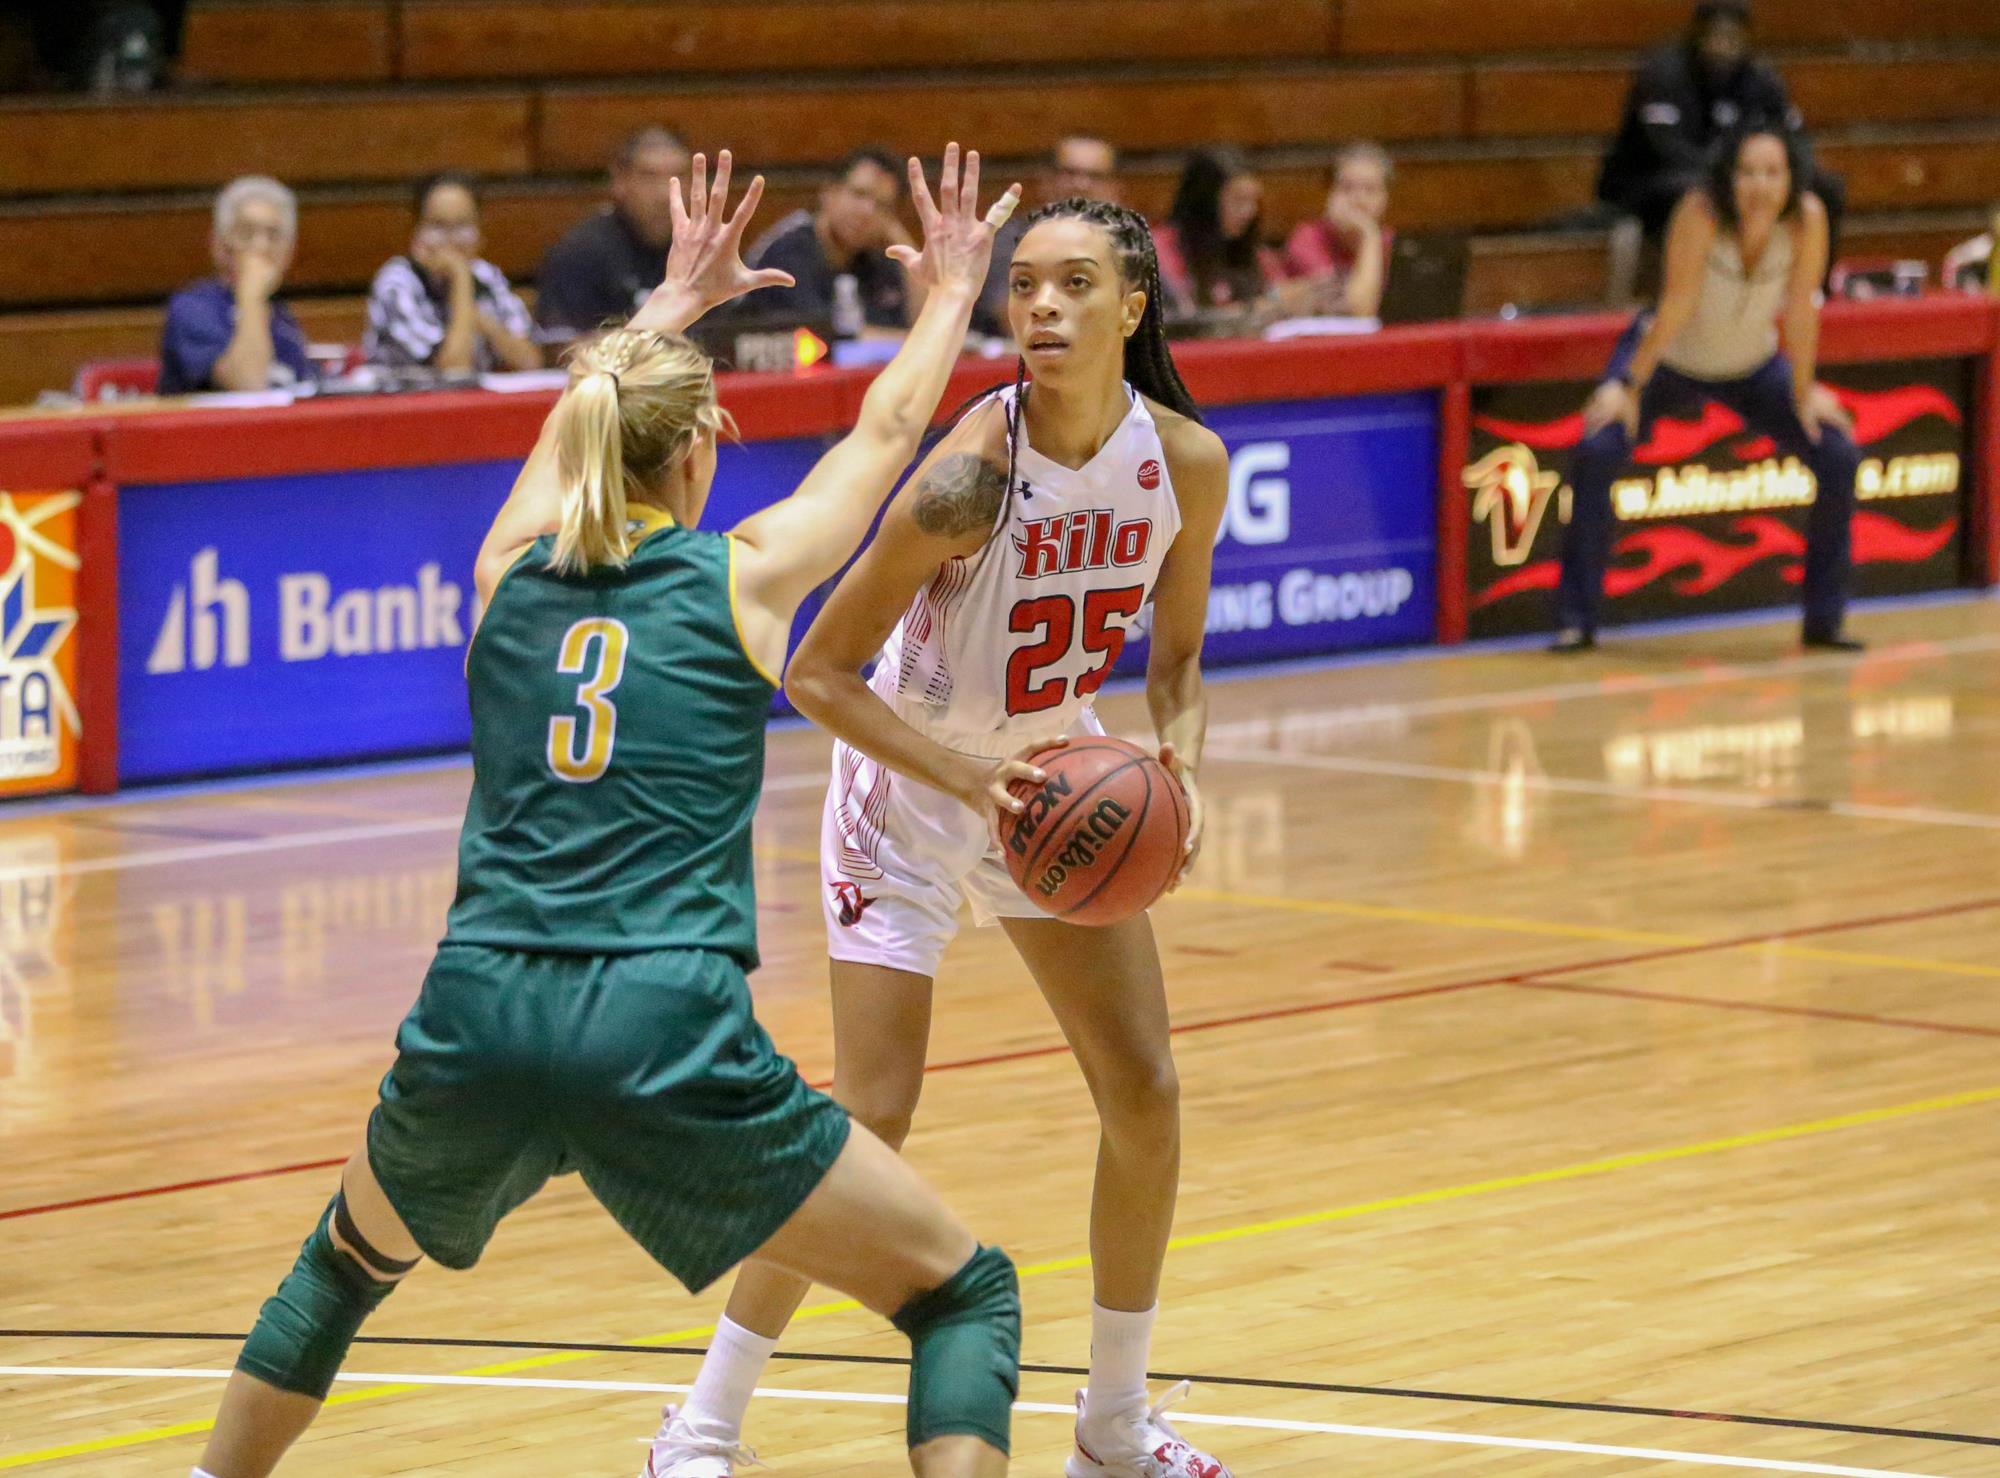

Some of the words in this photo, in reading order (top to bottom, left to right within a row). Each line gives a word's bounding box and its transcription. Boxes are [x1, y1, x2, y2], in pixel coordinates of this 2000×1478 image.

[278, 560, 466, 662] Bank
[1005, 582, 1145, 718] 25
[546, 616, 630, 784] 3
[1034, 796, 1133, 898] Wilson
